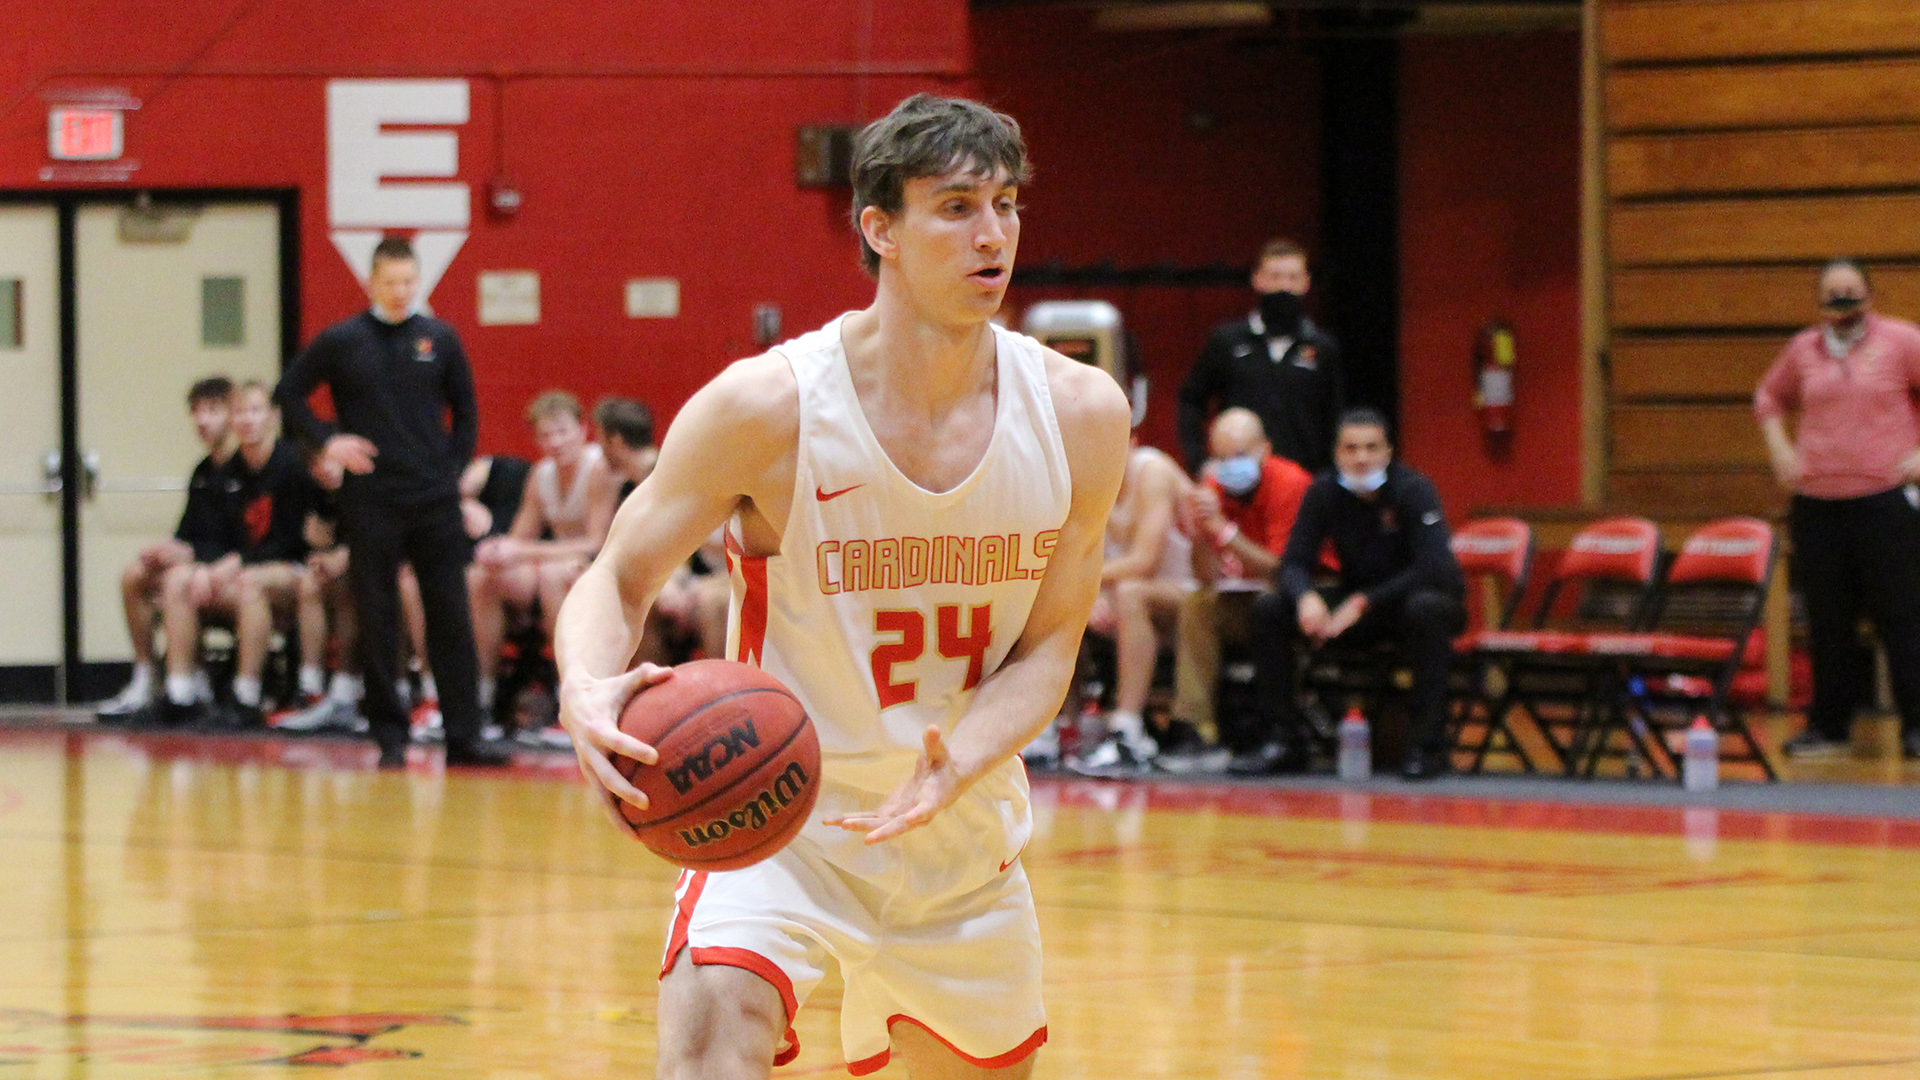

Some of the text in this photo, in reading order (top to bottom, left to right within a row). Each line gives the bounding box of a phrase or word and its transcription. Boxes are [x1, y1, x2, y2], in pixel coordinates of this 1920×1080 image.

[816, 529, 1061, 595] CARDINALS
[869, 600, 995, 714] 24
[664, 718, 760, 795] NCAA
[677, 761, 810, 847] Wilson
